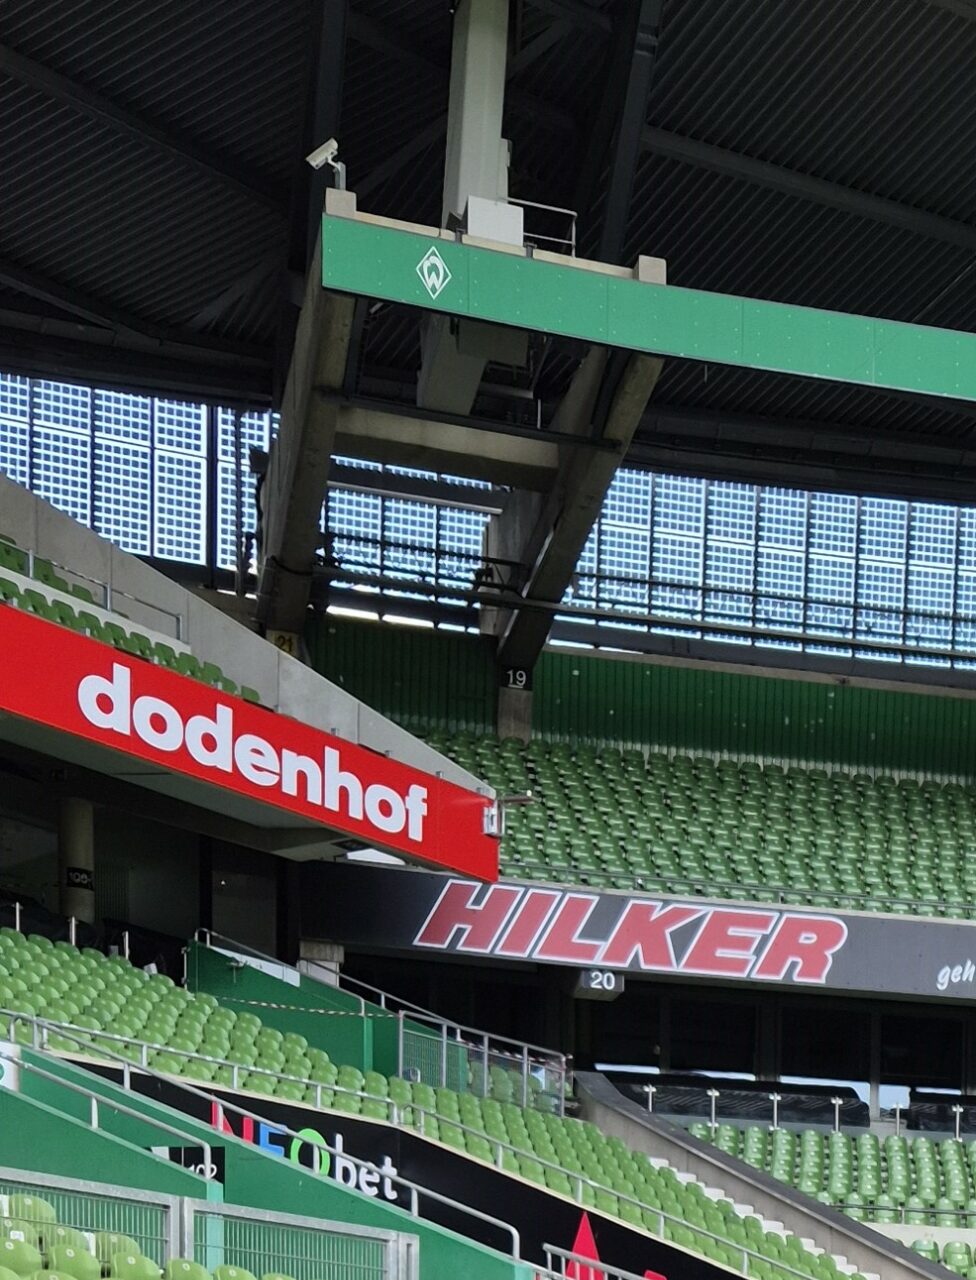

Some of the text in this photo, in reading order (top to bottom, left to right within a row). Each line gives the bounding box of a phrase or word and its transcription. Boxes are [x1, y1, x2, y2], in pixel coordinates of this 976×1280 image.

[507, 669, 527, 686] 19
[78, 661, 428, 842] dodenhof
[412, 878, 848, 984] HILKER
[590, 972, 616, 991] 20
